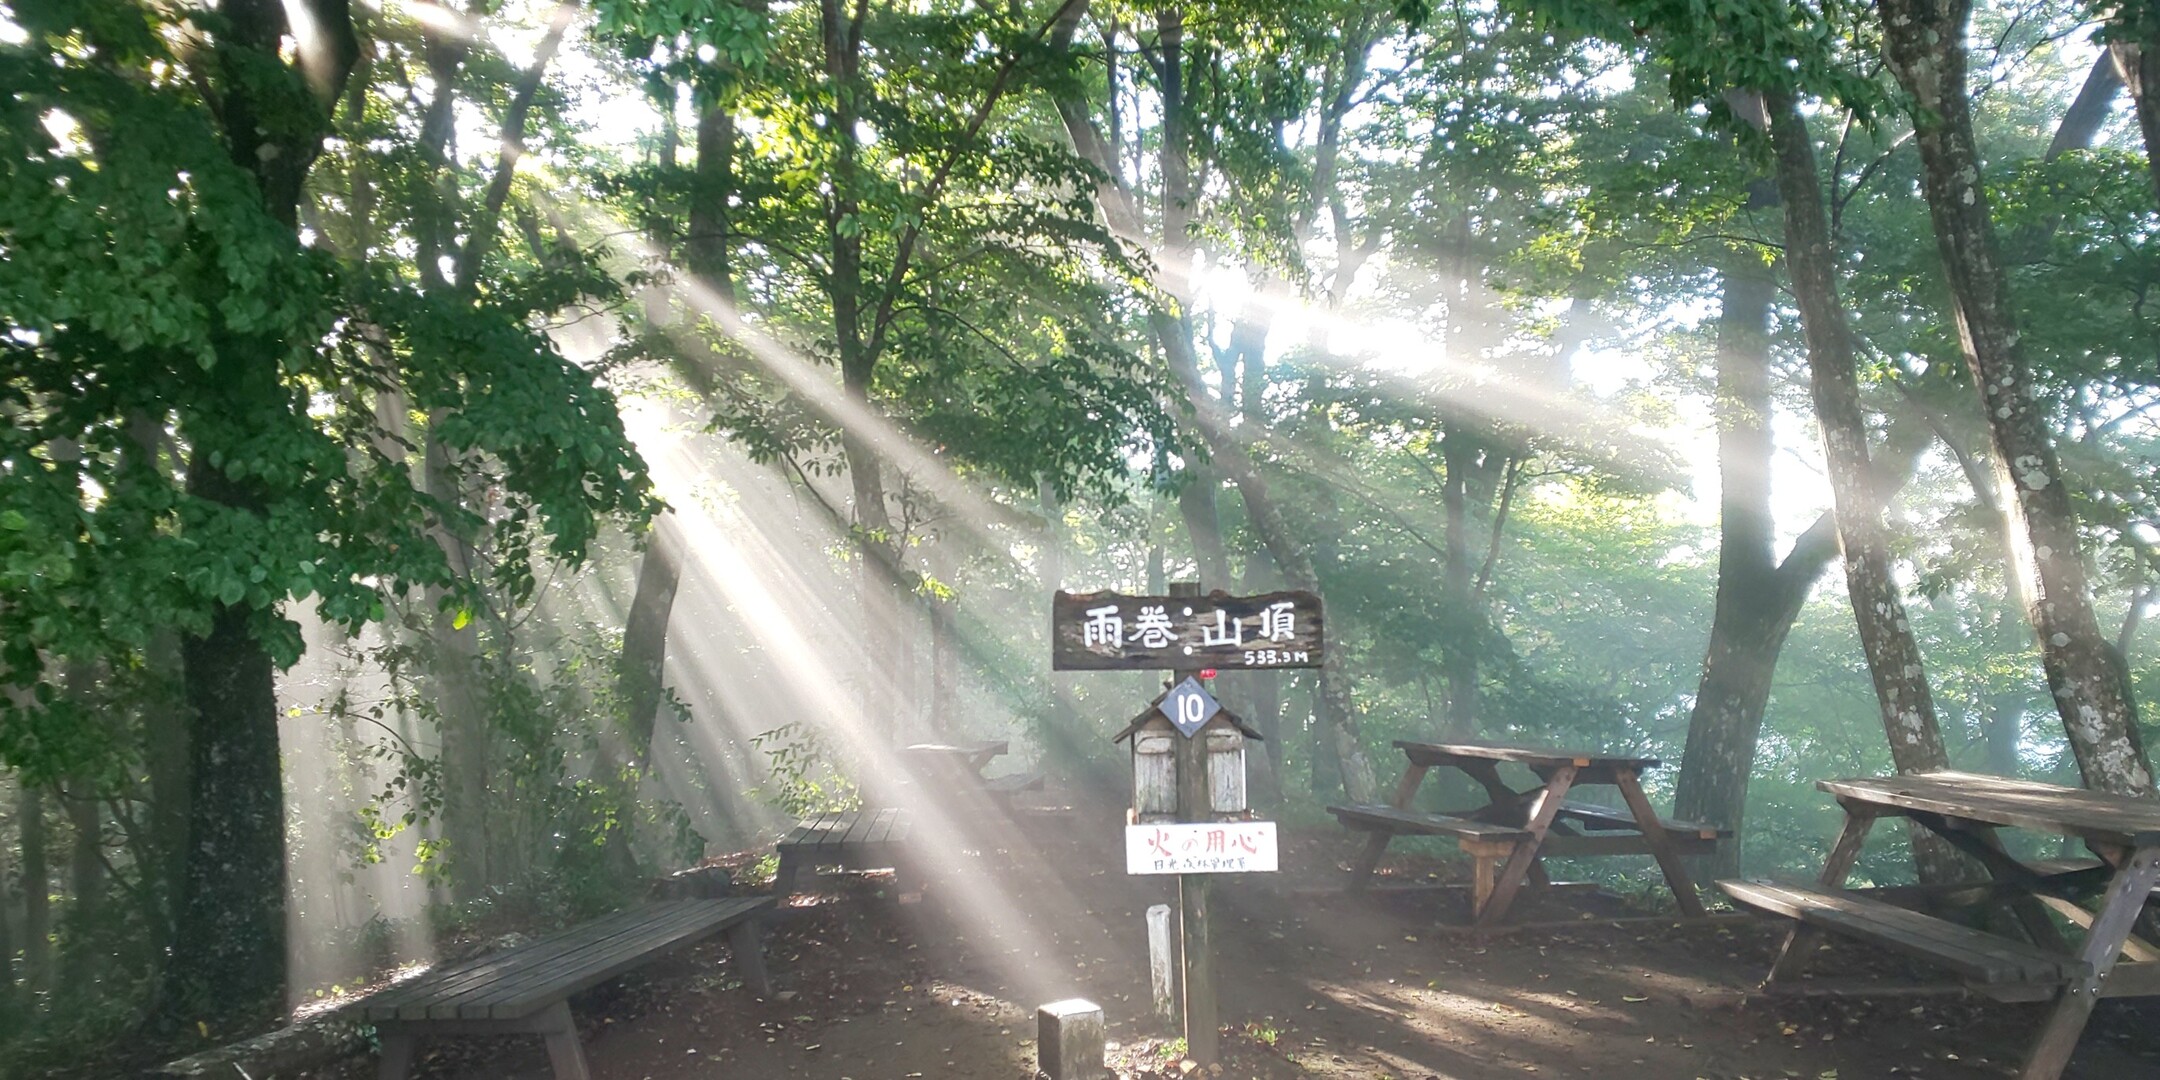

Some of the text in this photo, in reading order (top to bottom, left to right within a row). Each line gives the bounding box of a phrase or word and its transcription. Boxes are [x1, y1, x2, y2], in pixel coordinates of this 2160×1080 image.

[1083, 601, 1296, 649] 雨巻山頂
[1177, 693, 1205, 725] 10
[1147, 828, 1264, 857] 火の用心
